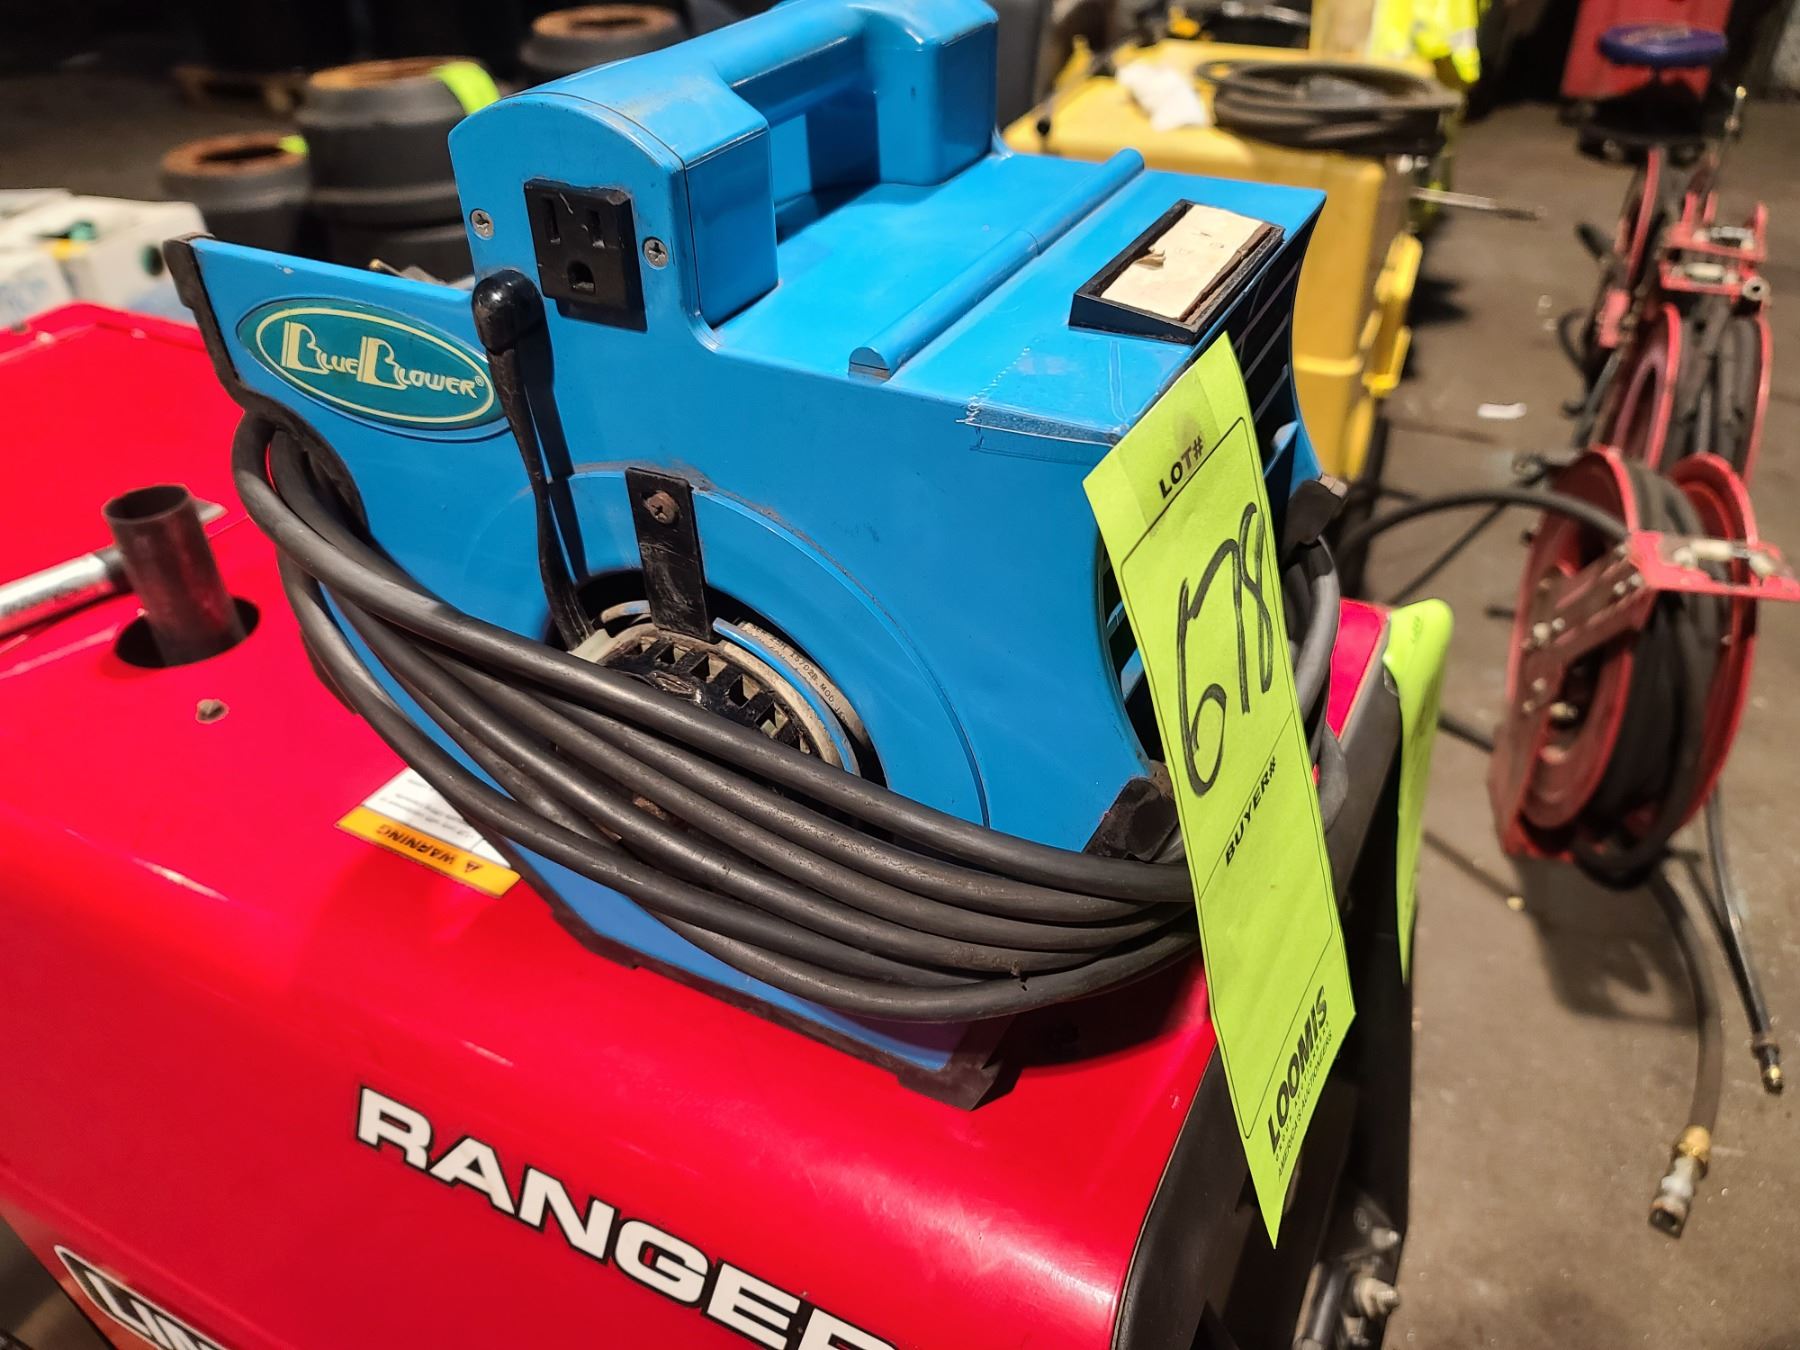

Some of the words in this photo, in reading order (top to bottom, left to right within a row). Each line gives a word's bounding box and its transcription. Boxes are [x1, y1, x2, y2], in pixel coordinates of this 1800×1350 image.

[1159, 435, 1203, 499] LOT#
[1177, 502, 1274, 798] 678
[376, 823, 457, 866] WARNING
[1226, 756, 1276, 867] BUYER#
[1268, 985, 1328, 1154] LOOMIS
